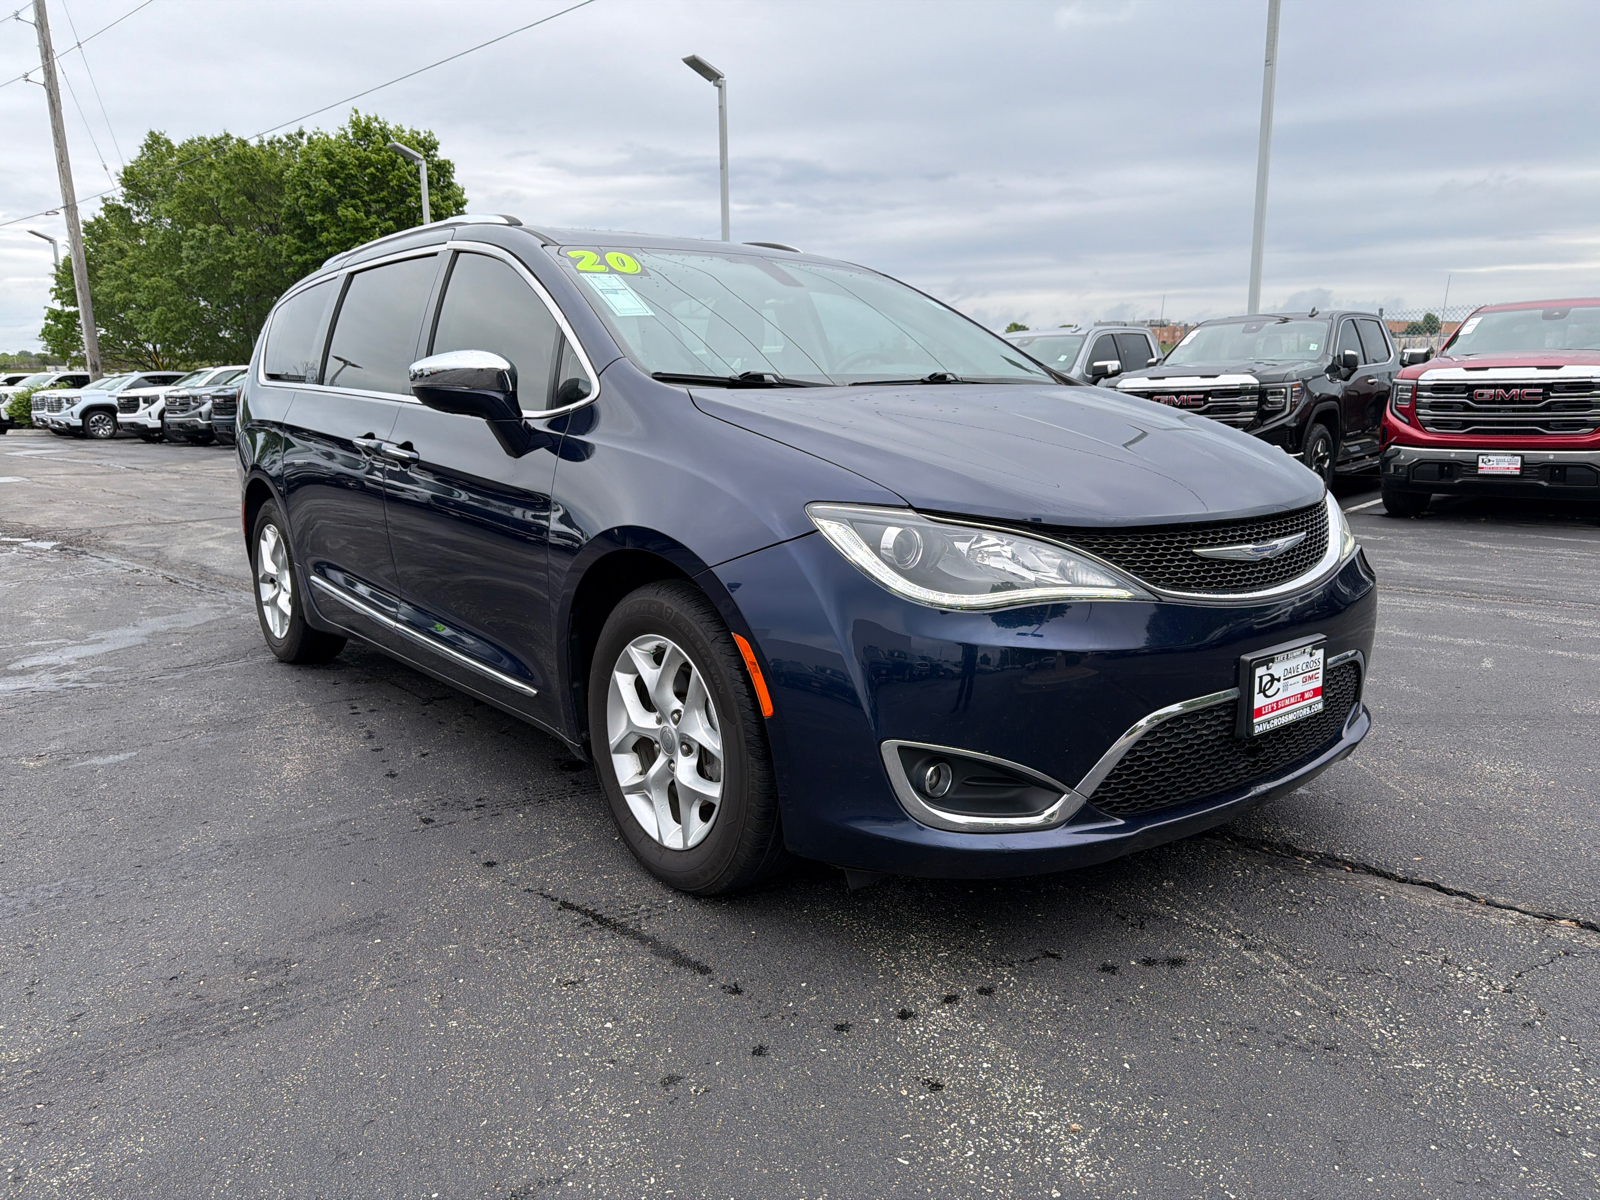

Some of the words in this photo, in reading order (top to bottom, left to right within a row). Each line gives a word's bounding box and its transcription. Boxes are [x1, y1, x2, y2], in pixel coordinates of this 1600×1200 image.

[567, 250, 642, 274] 20
[1153, 395, 1204, 406] GMC
[1474, 388, 1543, 401] GMC
[677, 622, 695, 642] ALL
[693, 641, 726, 695] SEASON
[1283, 664, 1300, 677] DAVE
[1301, 657, 1321, 671] CROSS
[1301, 672, 1320, 684] GMC
[1262, 702, 1277, 715] LEE'S
[1278, 694, 1303, 709] SUMMIT,
[1304, 690, 1314, 699] MO
